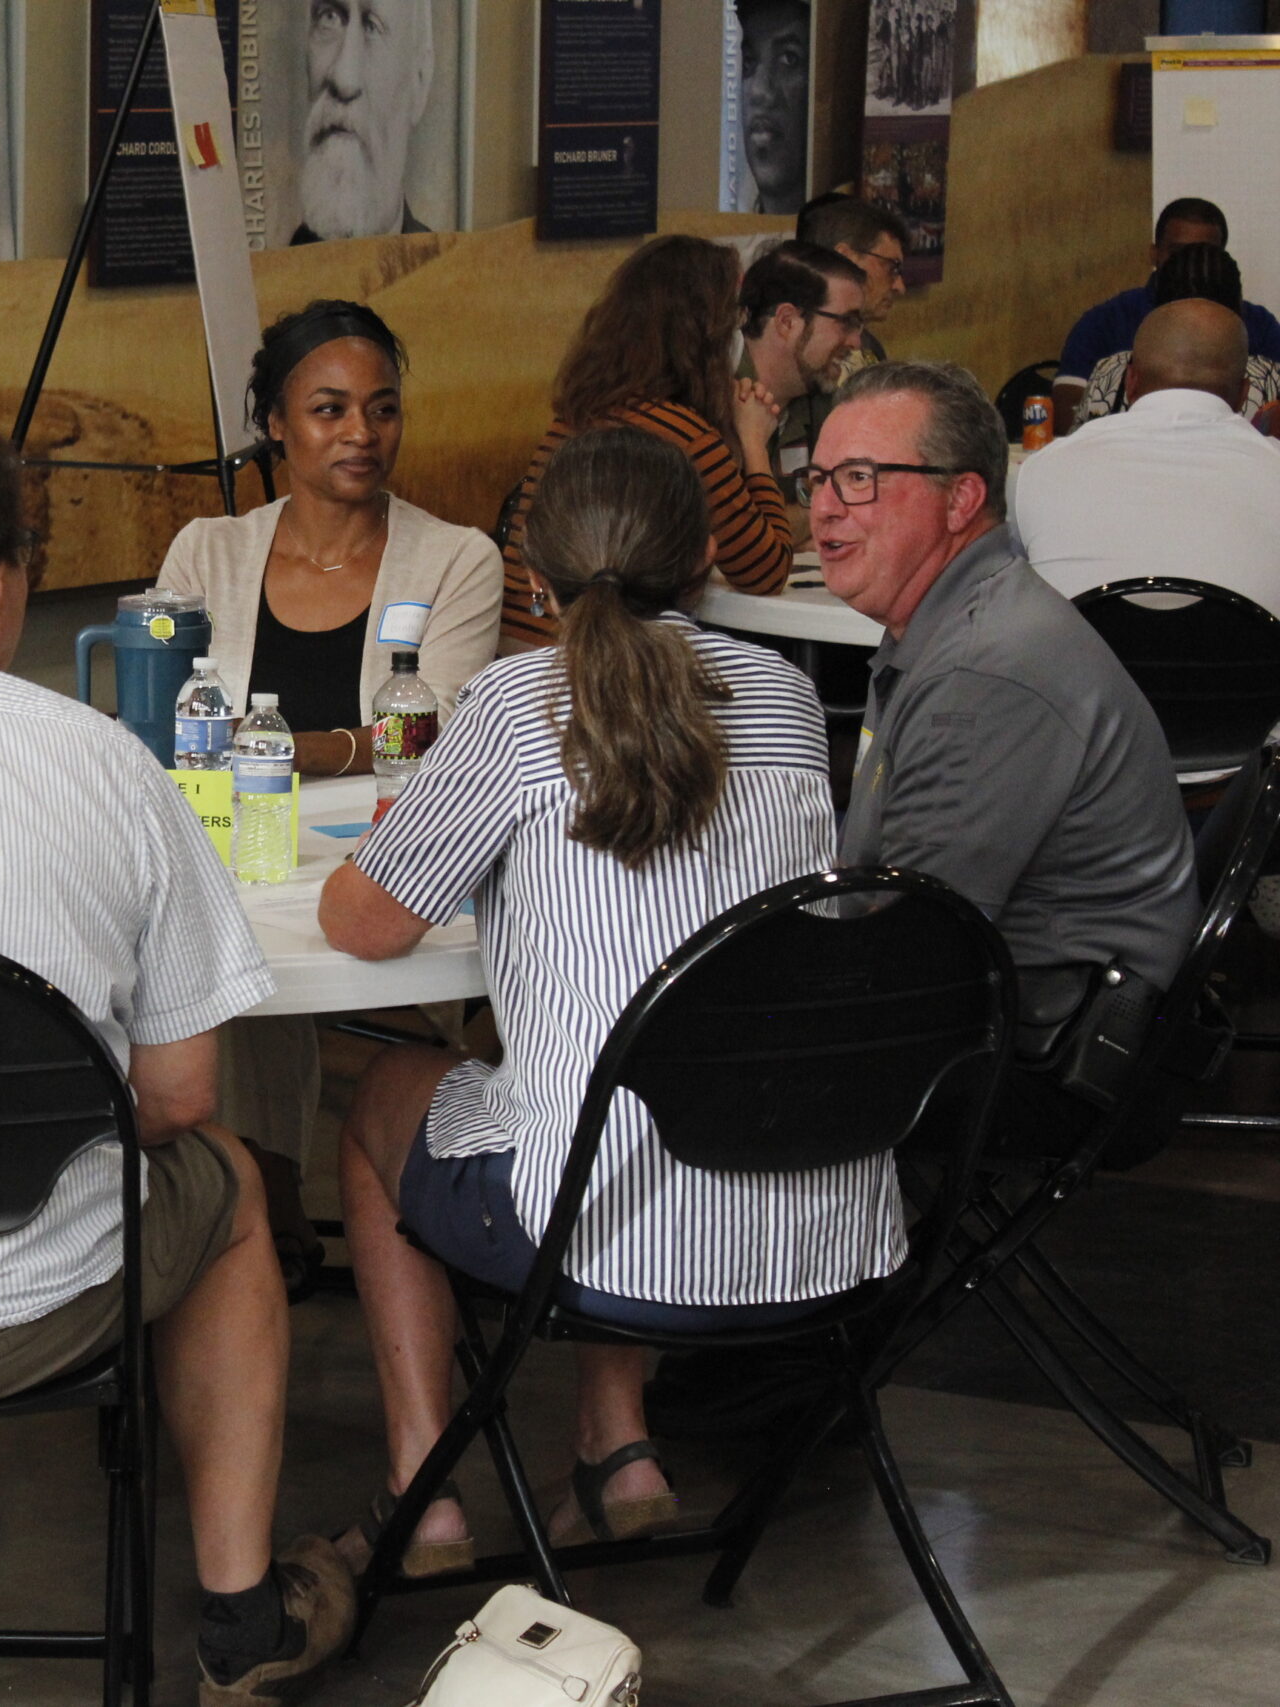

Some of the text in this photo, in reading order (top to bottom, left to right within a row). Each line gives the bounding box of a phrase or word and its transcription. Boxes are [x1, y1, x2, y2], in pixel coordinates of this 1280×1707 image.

[240, 0, 266, 252] CHARLES ROBIN
[553, 149, 618, 164] RICHARD BRUNER
[198, 815, 232, 828] ERS
